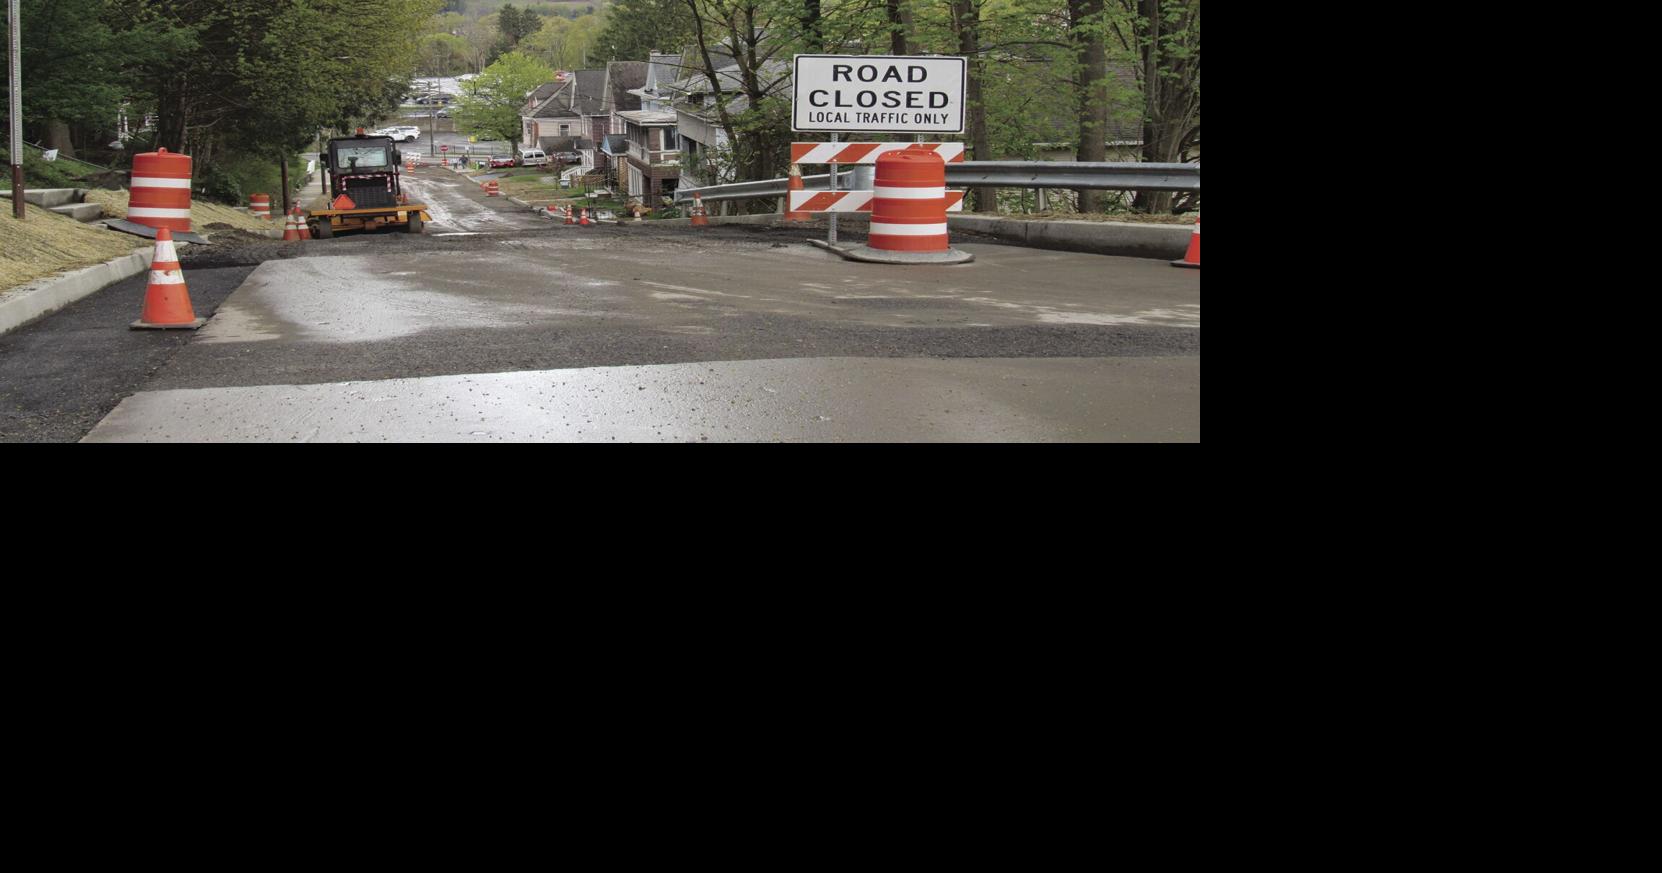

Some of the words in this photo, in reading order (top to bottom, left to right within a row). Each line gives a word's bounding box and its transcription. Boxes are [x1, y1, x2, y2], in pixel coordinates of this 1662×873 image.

[832, 64, 928, 83] ROAD
[808, 89, 949, 109] CLOSED
[808, 111, 850, 123] LOCAL
[855, 112, 908, 124] TRAFFIC
[914, 113, 949, 125] ONLY
